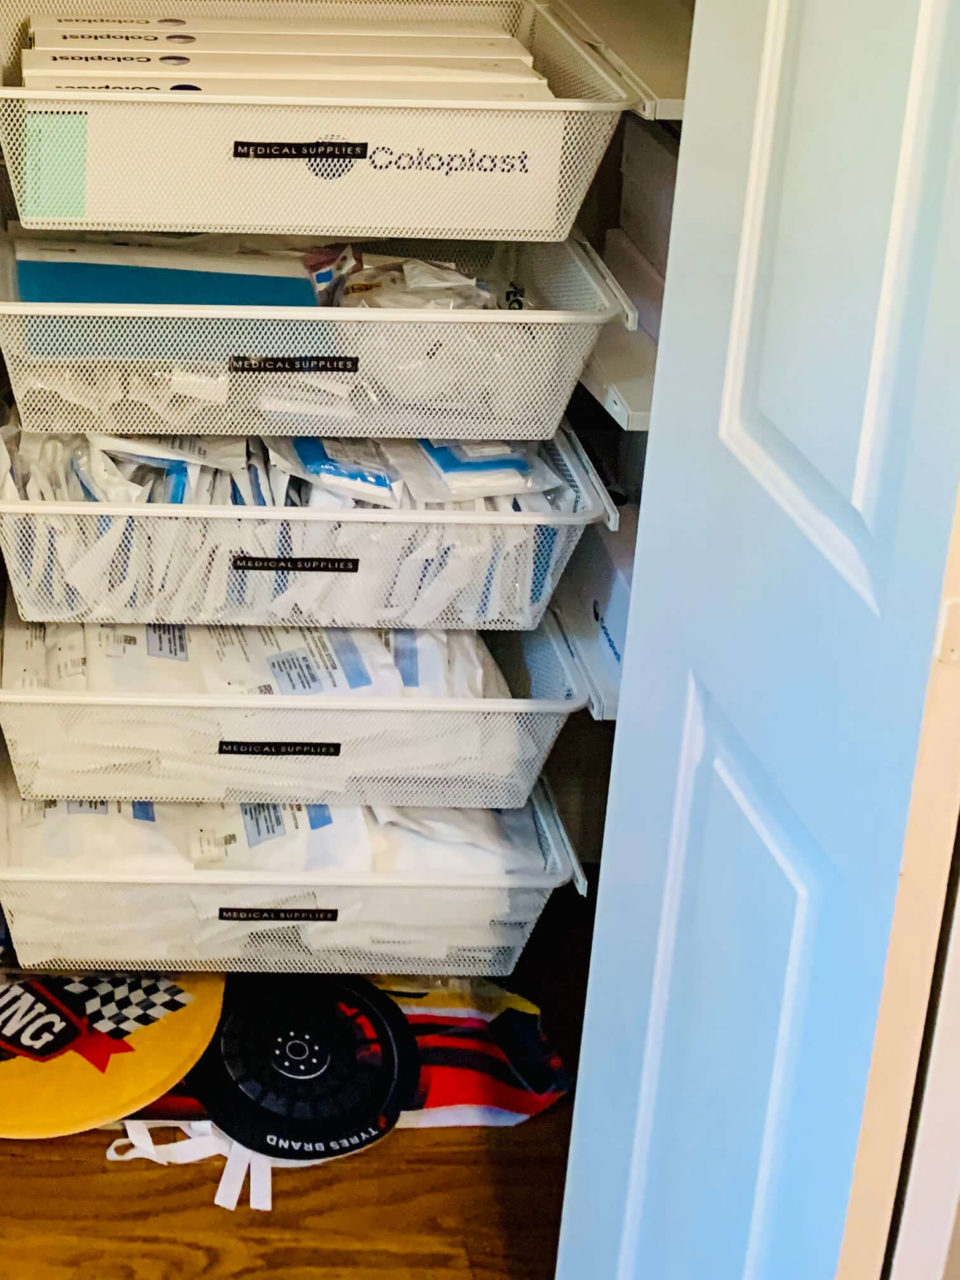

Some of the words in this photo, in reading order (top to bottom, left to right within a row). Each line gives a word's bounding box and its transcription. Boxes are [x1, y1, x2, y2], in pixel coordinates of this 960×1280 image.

[61, 33, 159, 42] Coloplast
[50, 54, 152, 63] Coloplast
[236, 144, 298, 155] MEDICAL
[301, 145, 362, 156] SUPPLIES
[368, 145, 529, 176] Coloplast
[232, 360, 292, 369] MEDICAL
[294, 360, 353, 369] SUPPLIES
[235, 559, 293, 569] MEDICAL
[296, 560, 354, 569] SUPPLIES
[221, 744, 277, 753] MEDICAL
[280, 745, 335, 753] SUPPLIES
[221, 910, 276, 919] MEDICAL
[279, 911, 333, 919] SUPPLIES
[265, 1134, 326, 1152] BRAND
[328, 1126, 379, 1151] TYRES
